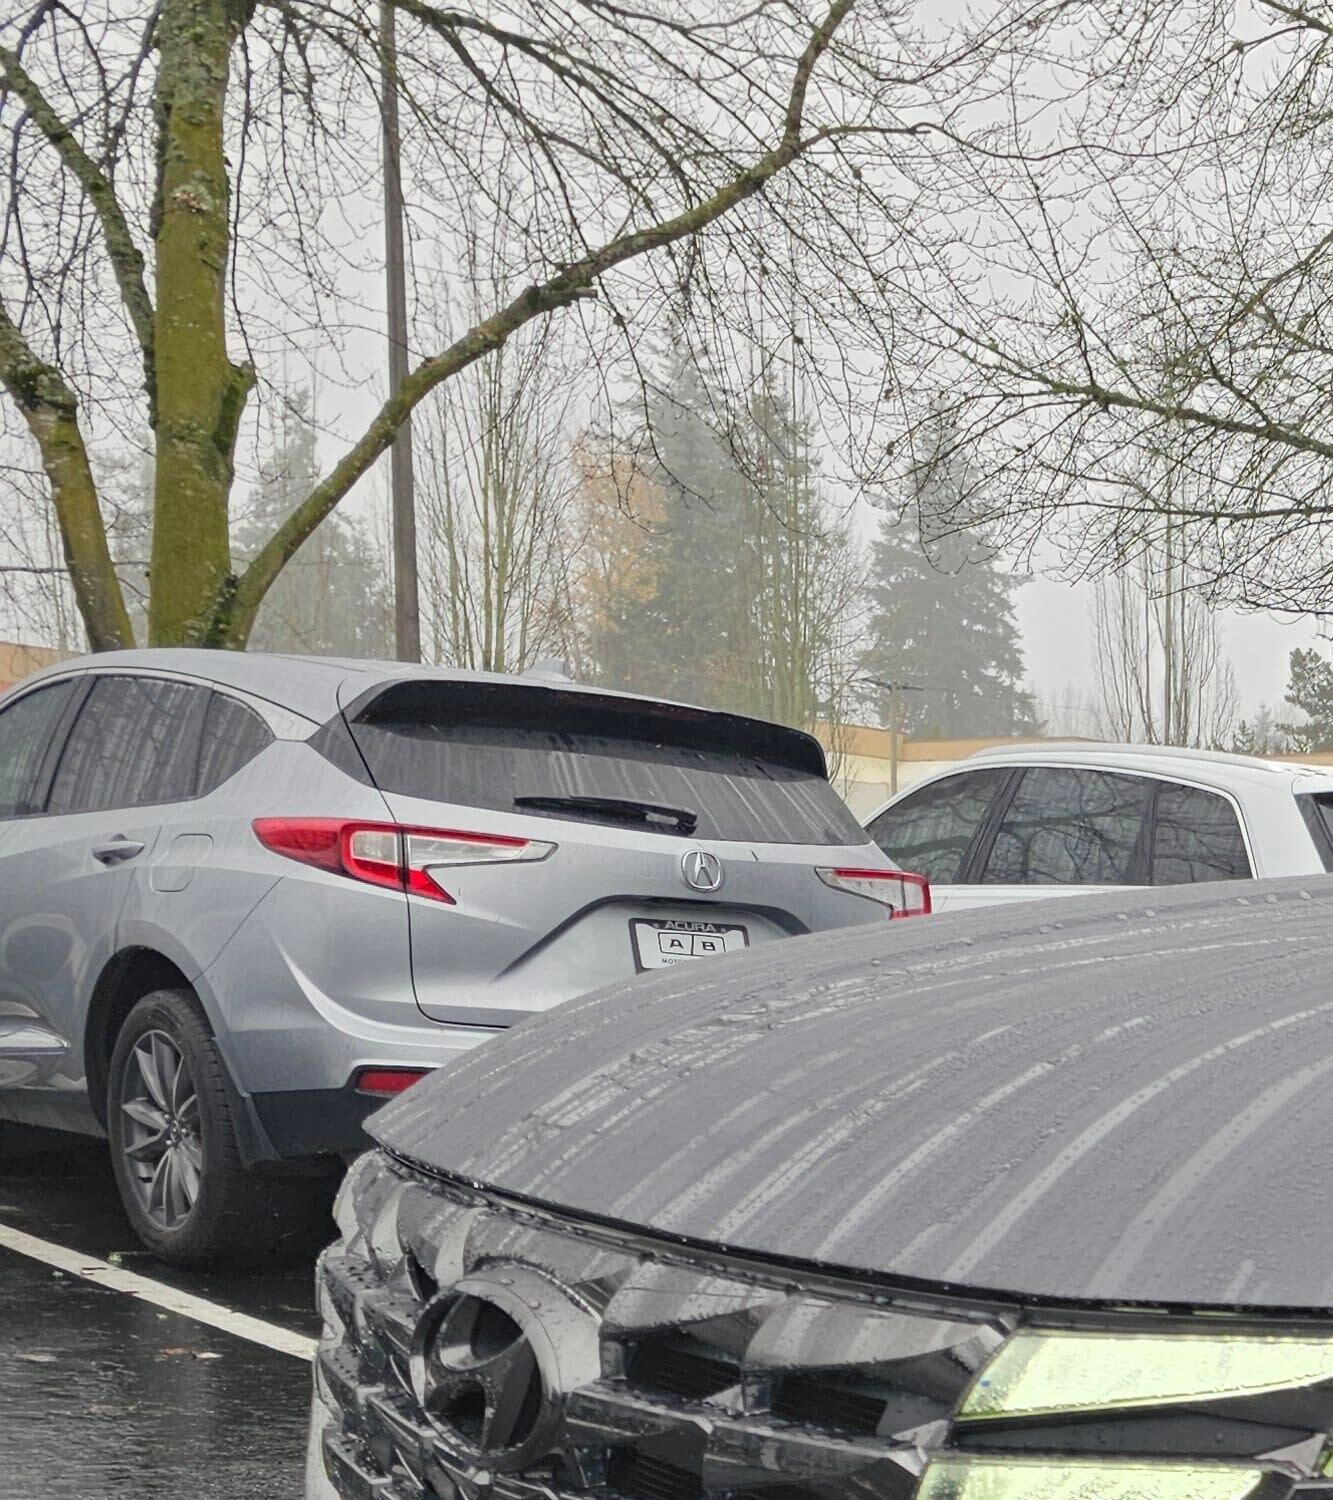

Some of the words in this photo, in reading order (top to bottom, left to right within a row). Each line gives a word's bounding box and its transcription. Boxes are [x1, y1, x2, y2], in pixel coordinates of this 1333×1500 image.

[665, 921, 716, 932] ACURA
[671, 939, 683, 949] A
[702, 941, 715, 950] B
